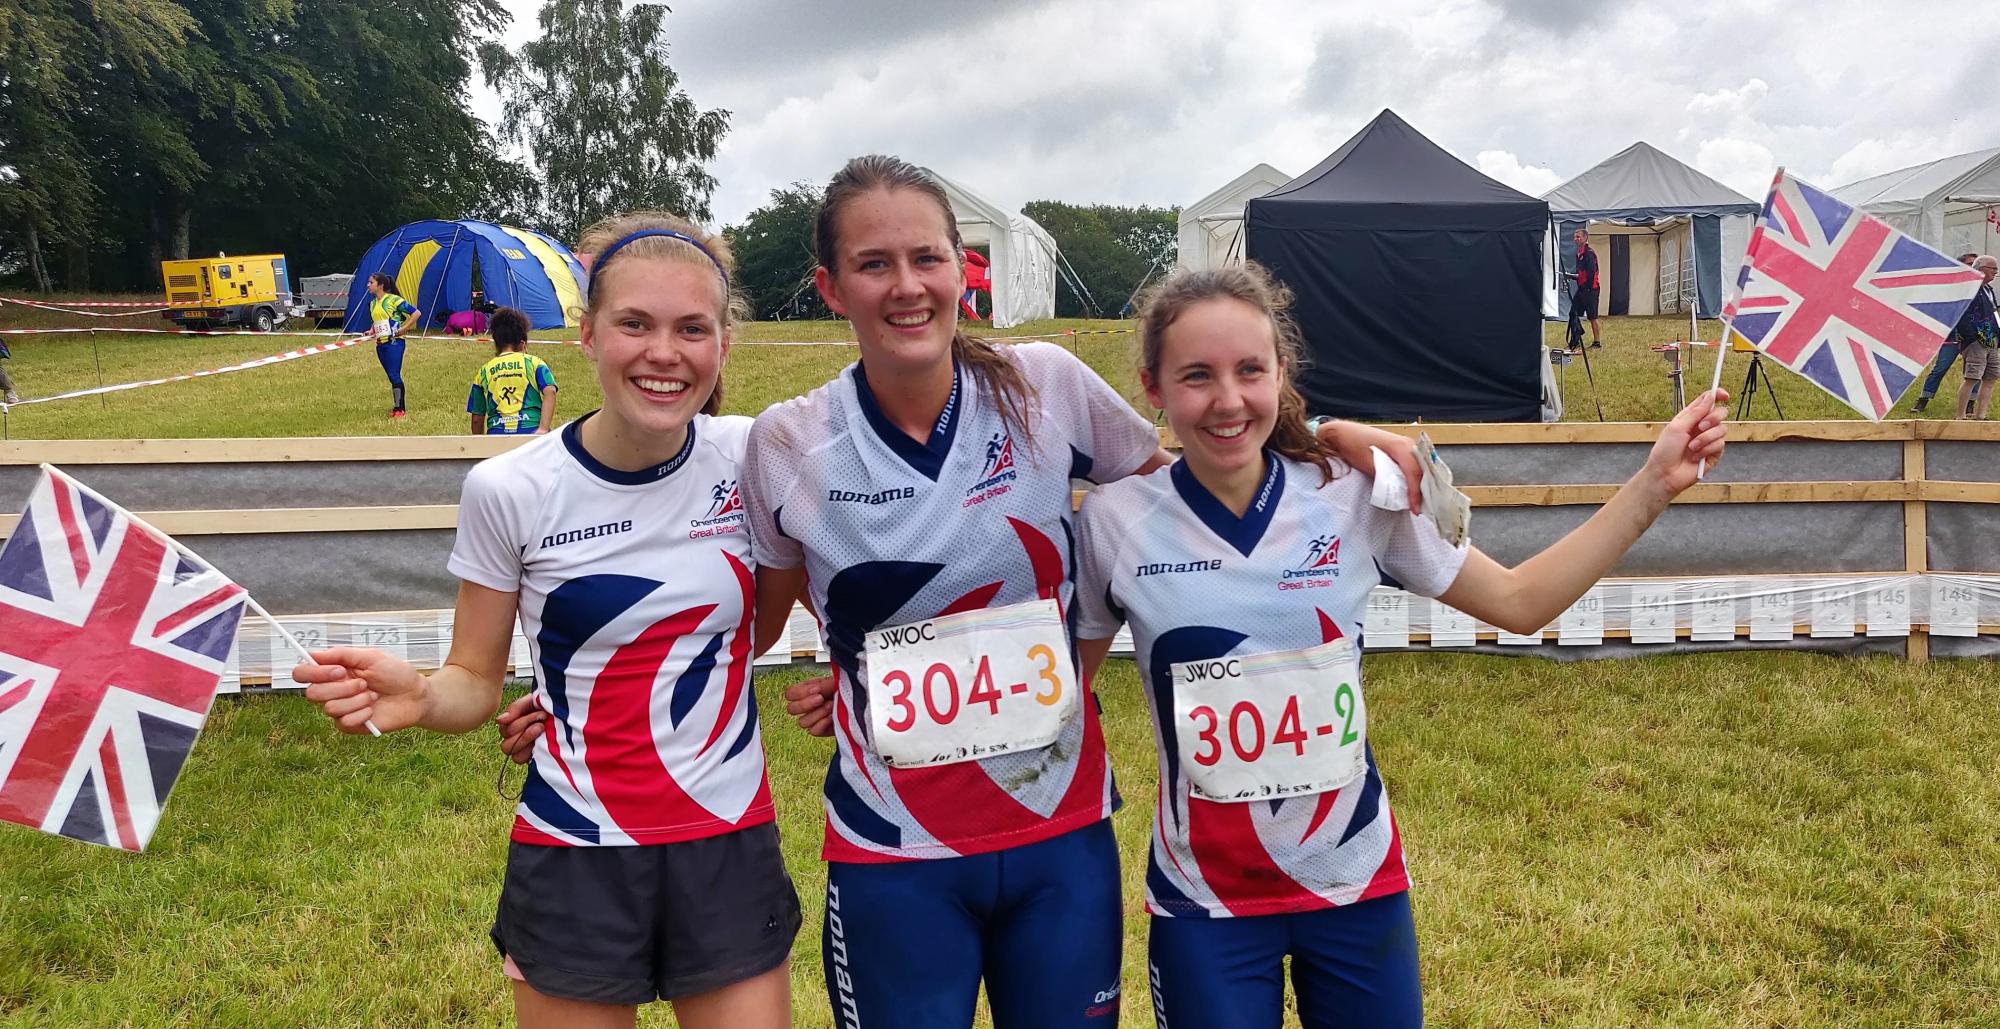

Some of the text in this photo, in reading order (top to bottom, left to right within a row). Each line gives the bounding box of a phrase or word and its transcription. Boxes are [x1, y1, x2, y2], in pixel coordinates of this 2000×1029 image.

[490, 361, 523, 375] BRASIL
[828, 486, 915, 505] noname
[690, 512, 744, 527] Orienteering
[540, 519, 632, 549] noname
[689, 523, 740, 539] Great Britain
[1136, 559, 1222, 577] noname
[1283, 568, 1339, 579] Orienteering
[1278, 581, 1304, 591] Great
[1759, 593, 1788, 608] 143
[1873, 589, 1905, 606] 145
[360, 627, 400, 645] 123
[879, 622, 936, 650] JWOC
[1185, 659, 1242, 683] JWOC
[881, 643, 1063, 733] 304-3
[1188, 682, 1358, 767] 304-2
